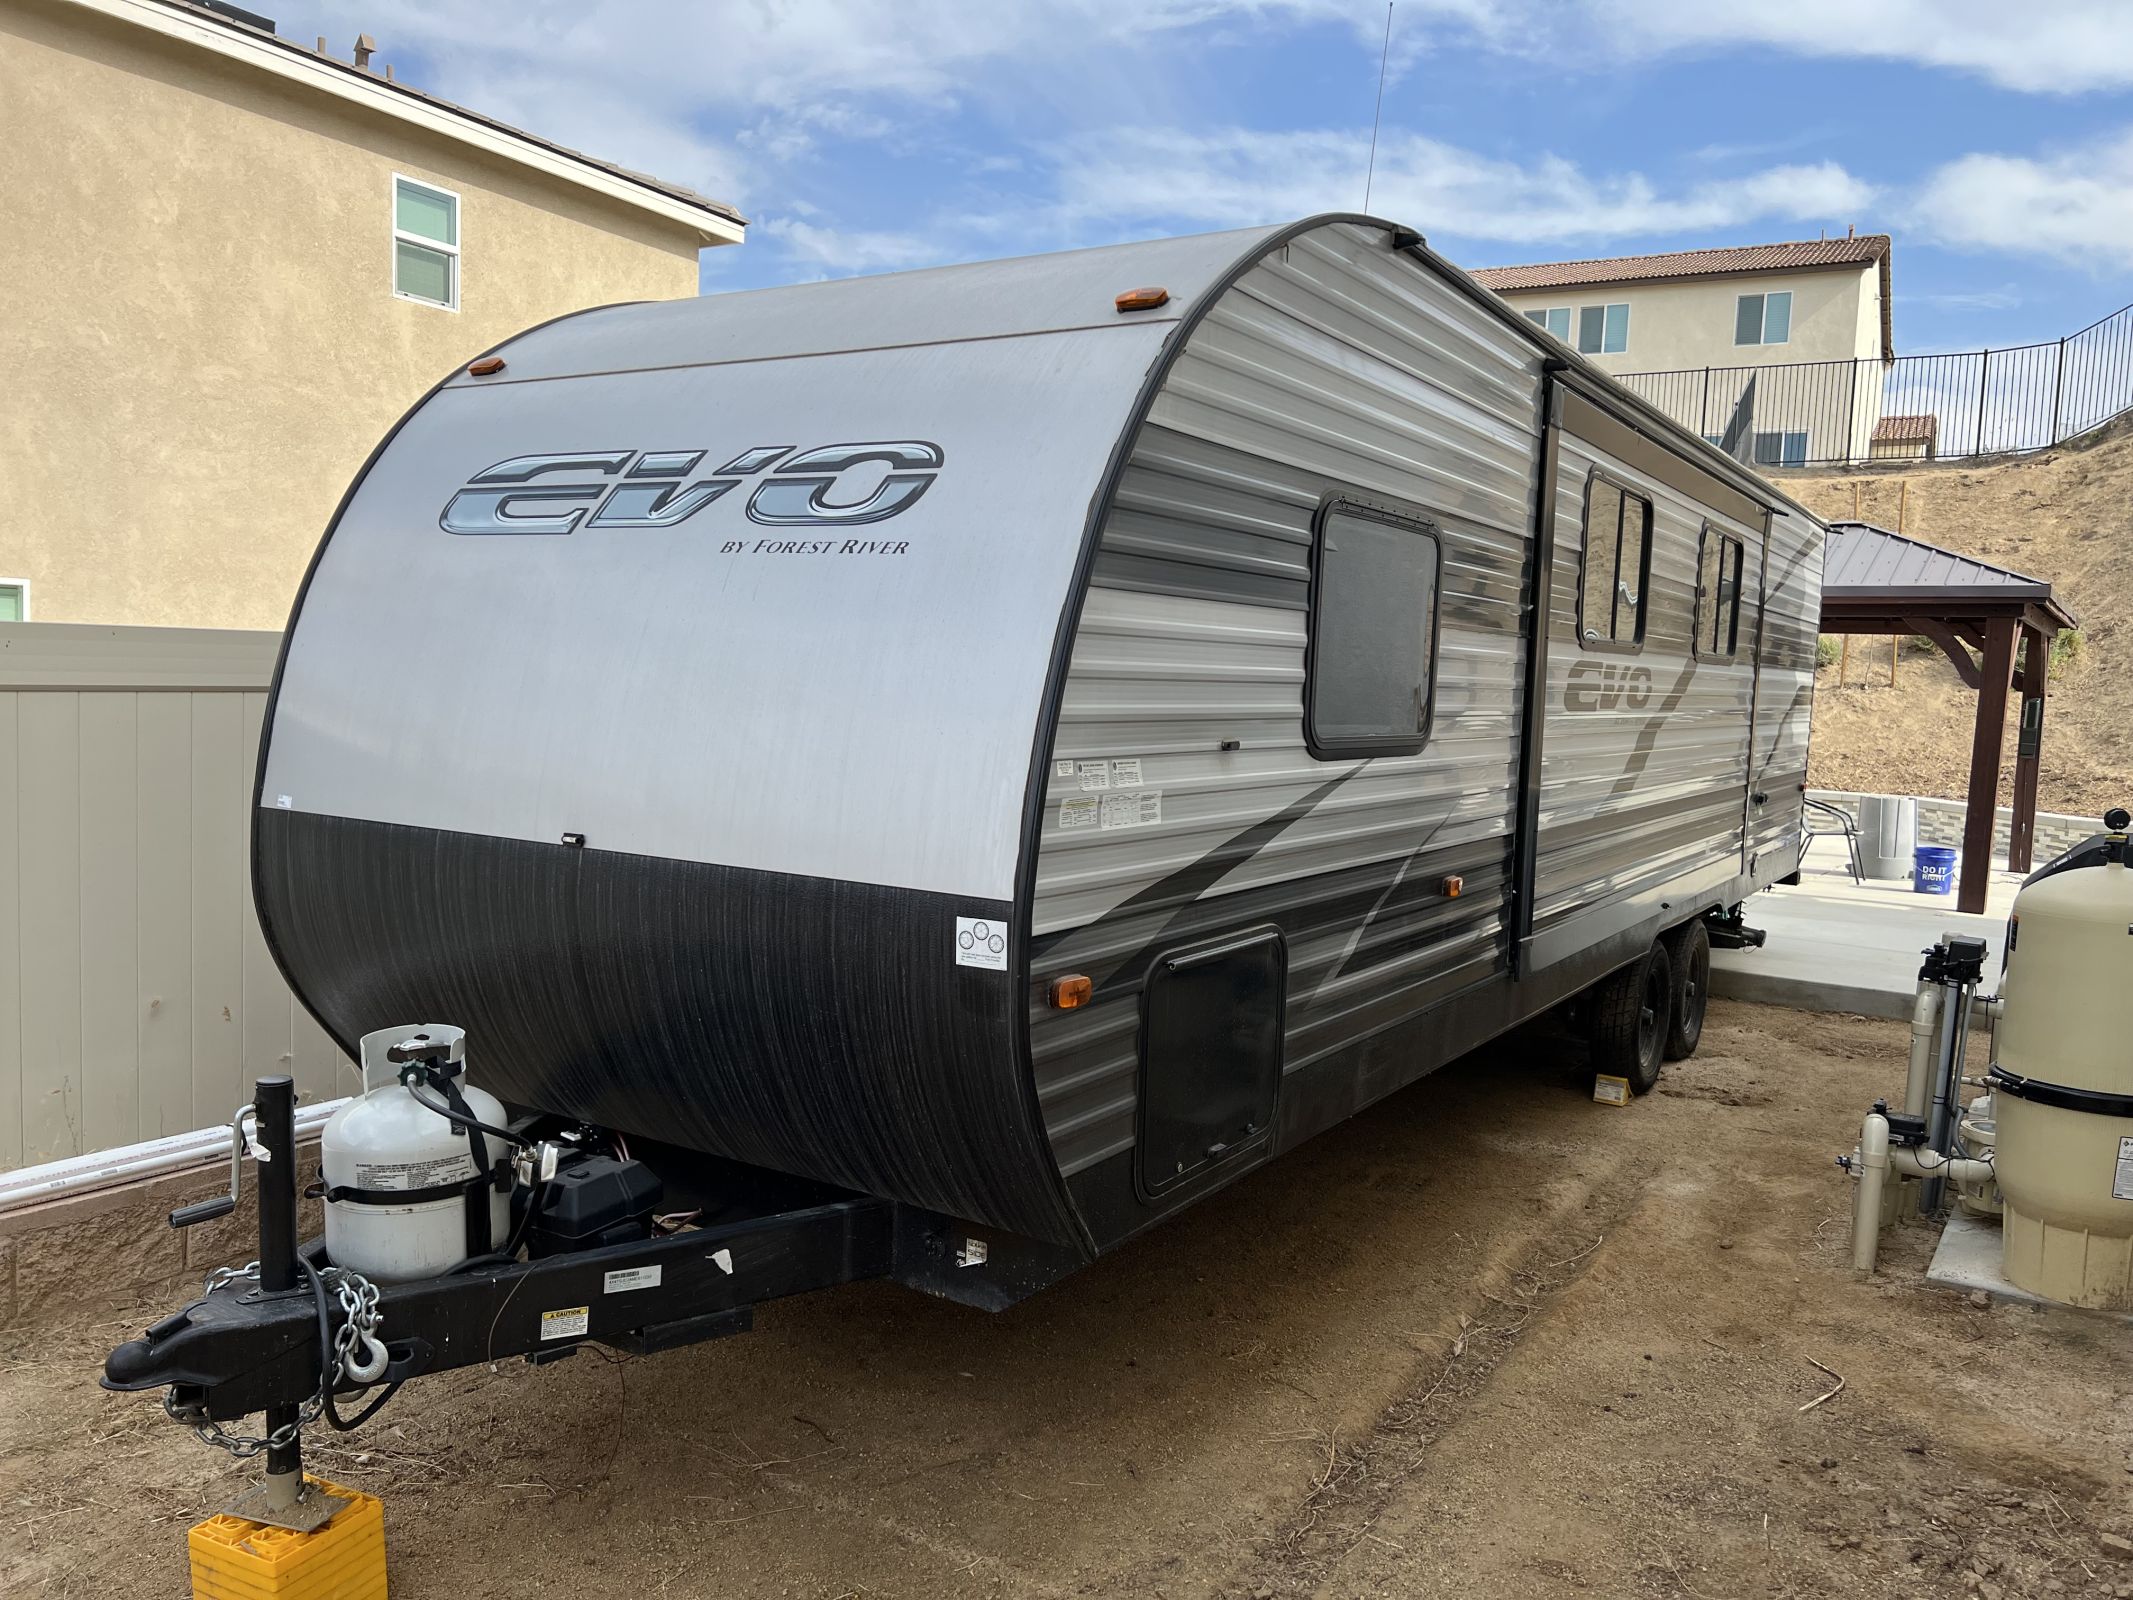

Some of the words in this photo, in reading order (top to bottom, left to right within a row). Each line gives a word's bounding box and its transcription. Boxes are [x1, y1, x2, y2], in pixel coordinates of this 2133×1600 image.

[439, 440, 945, 535] EVO
[720, 541, 750, 553] BY
[752, 539, 837, 554] FOREST
[839, 539, 910, 555] RIVER
[1564, 660, 1652, 712] EVO
[1922, 865, 1936, 874] DO
[1938, 866, 1947, 875] IT
